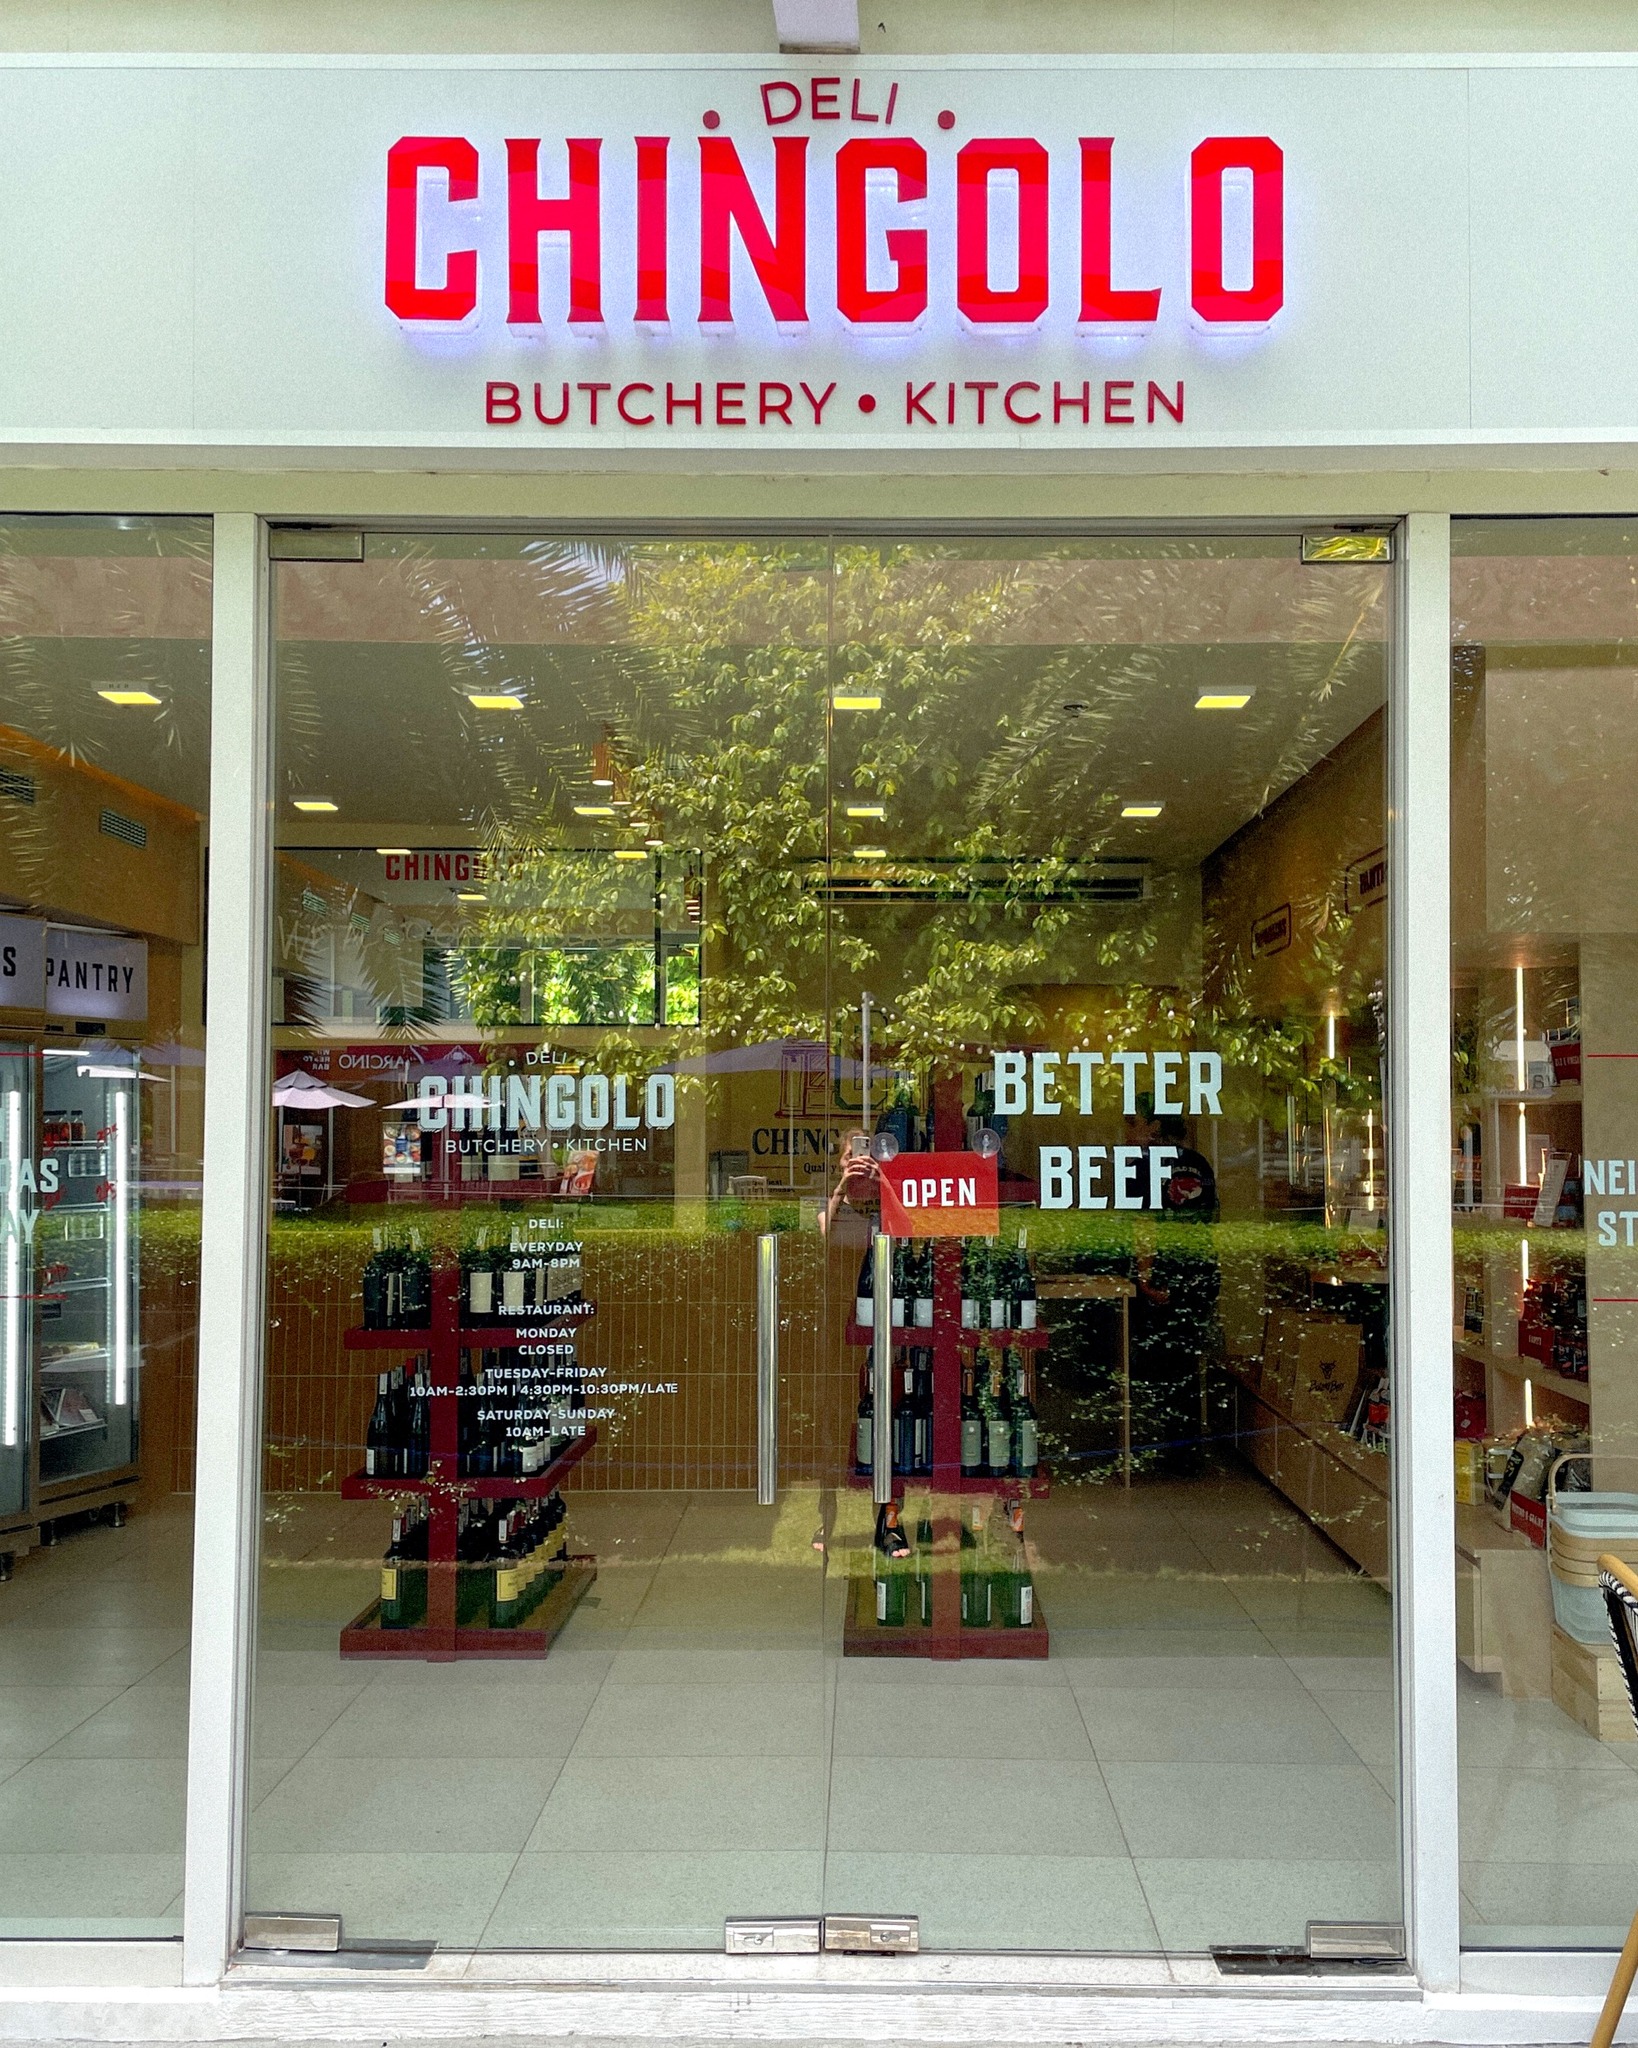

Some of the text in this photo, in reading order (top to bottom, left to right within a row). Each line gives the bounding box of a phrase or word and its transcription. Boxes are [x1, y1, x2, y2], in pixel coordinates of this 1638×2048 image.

[760, 77, 899, 125] DELI
[385, 136, 1283, 325] CHINGOLO
[485, 380, 1185, 426] BUTCHERY KITCHEN
[46, 957, 134, 994] PANTRY
[525, 1051, 568, 1066] DELI
[994, 1052, 1223, 1115] BETTER
[417, 1074, 676, 1132] CHINGOLO
[446, 1137, 647, 1154] BUTCHERY KITCHEN
[1039, 1146, 1178, 1209] BEEF
[1583, 1160, 1636, 1195] NEI
[902, 1177, 976, 1207] OPEN
[528, 1218, 564, 1229] DELI:
[509, 1241, 584, 1253] EVERYDAY
[512, 1258, 580, 1269] 9AM-8PM
[498, 1303, 595, 1316] RESTAURANT:
[516, 1328, 577, 1339] MONDAY
[518, 1345, 574, 1356] CLOSED
[485, 1367, 608, 1379] TUESDAY-FRIDAY
[409, 1385, 508, 1397] 10AM-2:30PM
[520, 1383, 678, 1396] 4:30PM-10:30PM/LATE
[477, 1408, 616, 1421] SATURDAY-SUNDAY
[506, 1426, 586, 1438] 10AM-LATE
